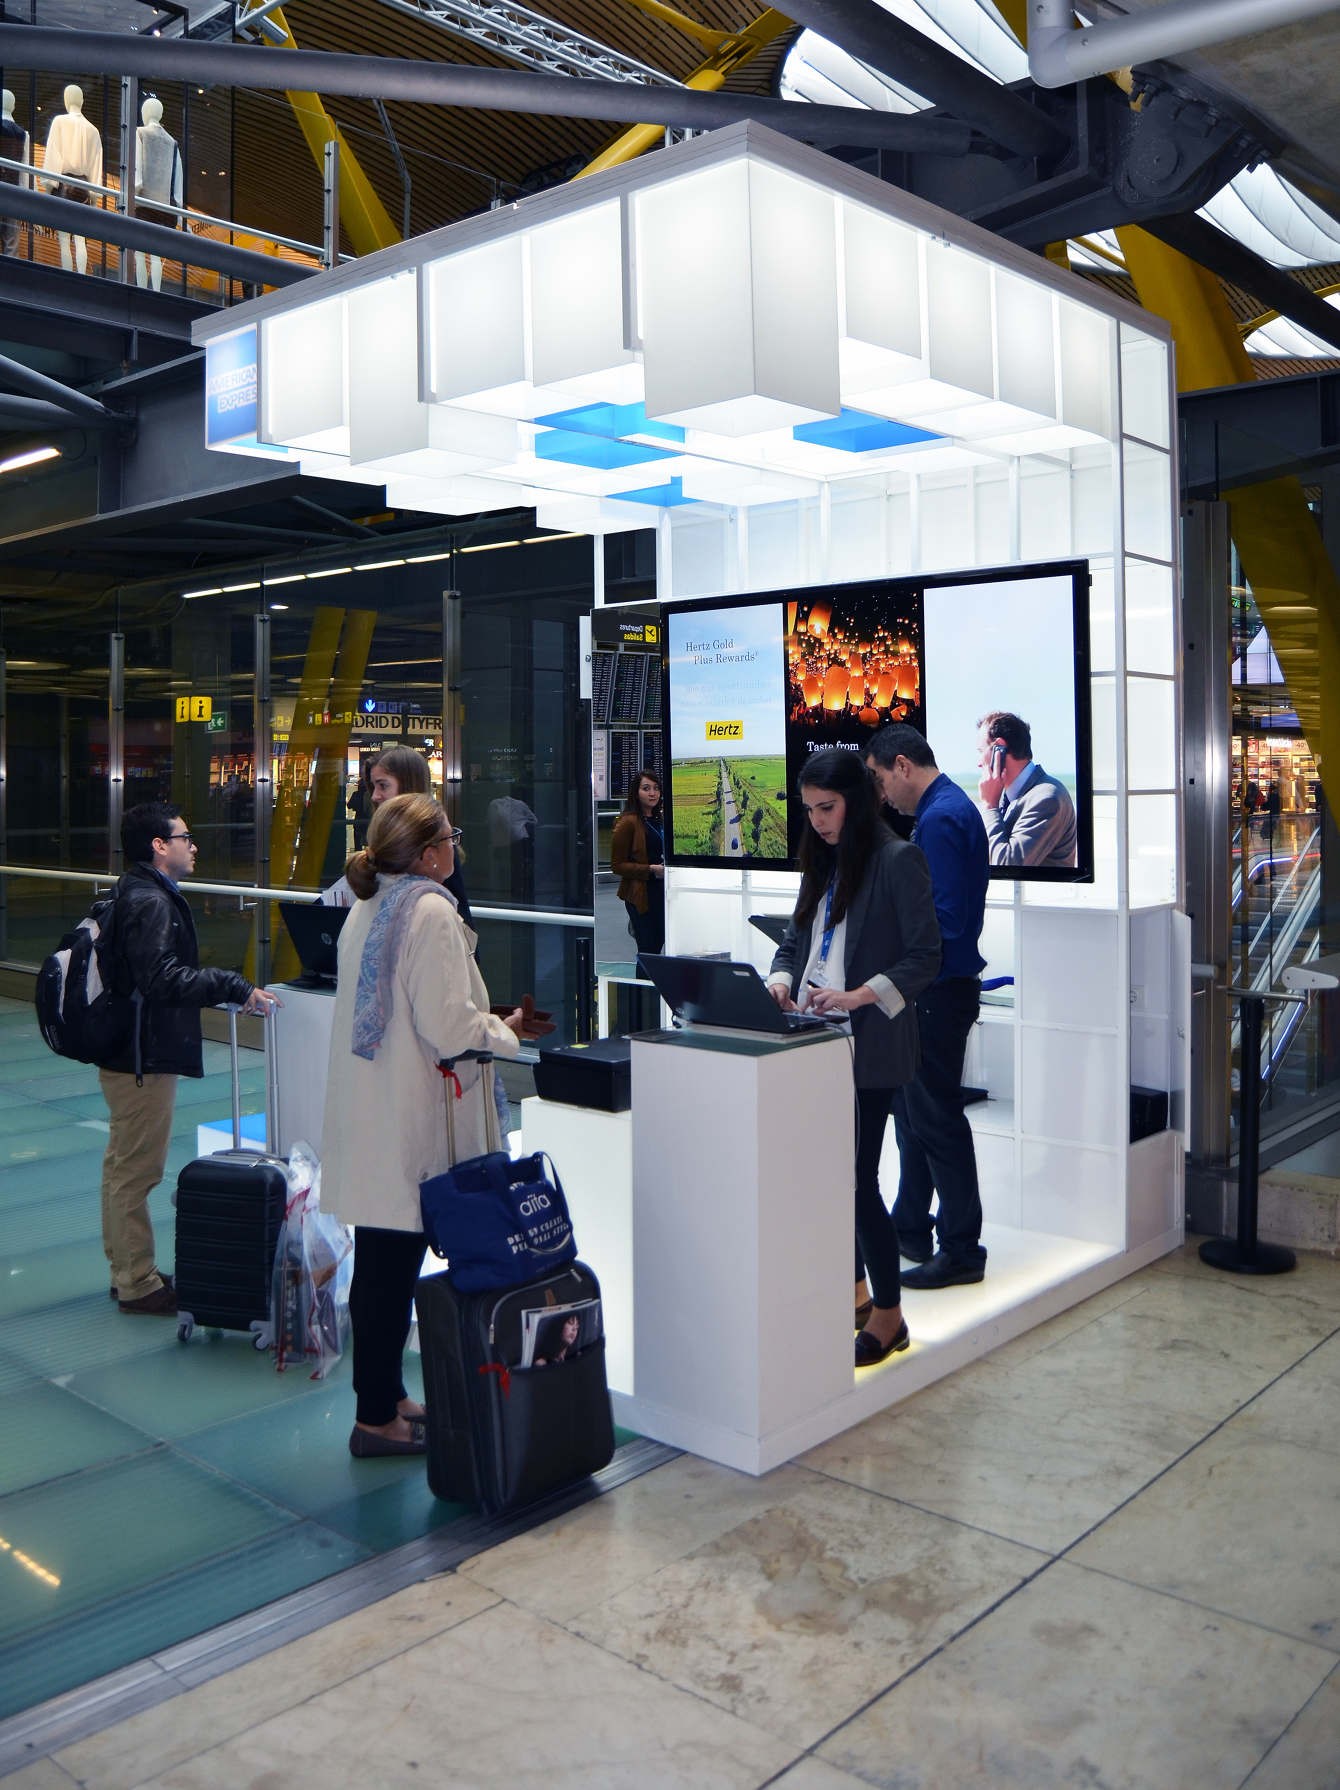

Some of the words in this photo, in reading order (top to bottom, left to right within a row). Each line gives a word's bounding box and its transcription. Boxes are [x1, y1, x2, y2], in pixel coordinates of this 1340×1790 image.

[217, 385, 257, 412] EXPRES
[685, 640, 710, 652] Hertz
[712, 638, 734, 649] Gold
[694, 655, 713, 665] Plus
[353, 715, 389, 728] DRID
[392, 716, 442, 730] DTYFR
[709, 723, 740, 736] Hertz
[806, 741, 834, 752] Taste
[836, 740, 859, 751] from
